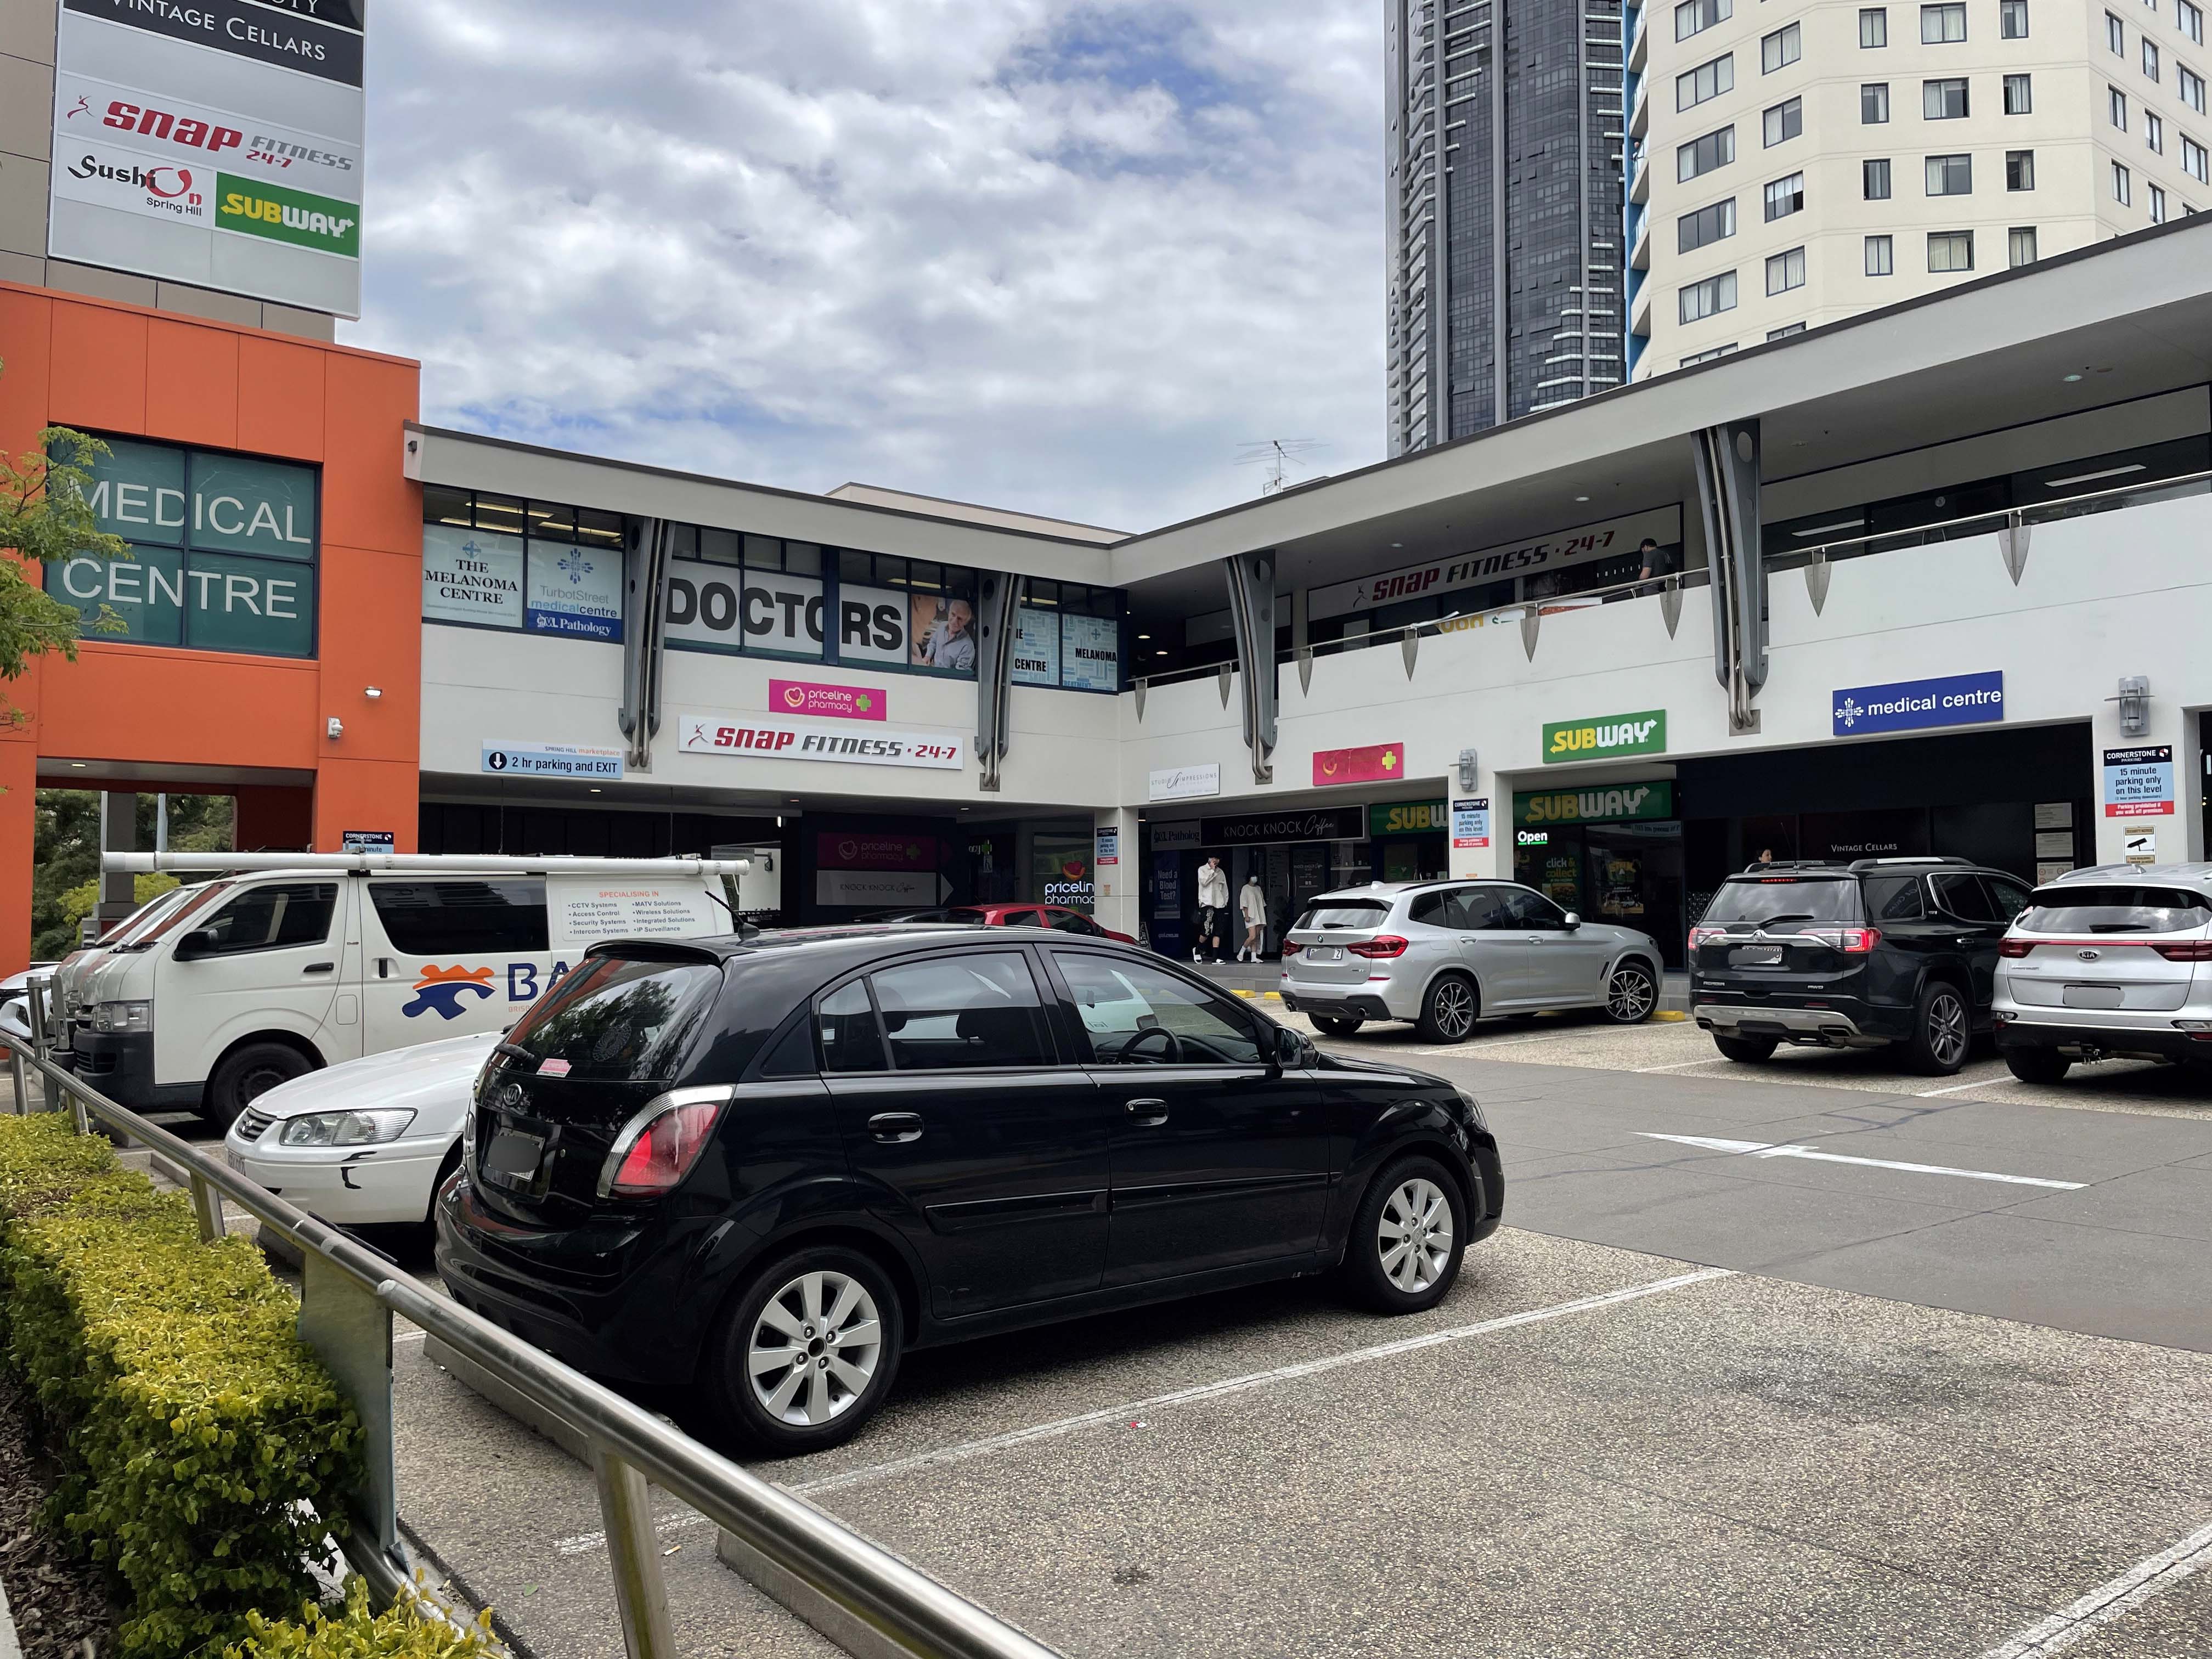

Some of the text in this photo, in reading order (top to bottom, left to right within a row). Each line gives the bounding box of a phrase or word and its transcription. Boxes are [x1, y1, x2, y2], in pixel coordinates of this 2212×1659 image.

[113, 0, 325, 61] INTAGE CELLARS
[246, 149, 293, 168] 24-7
[250, 135, 353, 171] FITNESS
[67, 155, 156, 189] Sushi
[146, 196, 202, 216] Spring Hill
[221, 193, 354, 238] SUBWAY
[68, 479, 312, 544] MEDICAL
[1446, 544, 1550, 584] FITNESS
[1563, 531, 1615, 556] 24-7
[456, 558, 489, 573] THE
[63, 558, 297, 619] CENTRE
[425, 570, 518, 592] MELANOMA
[440, 586, 504, 605] CENTRE
[560, 618, 612, 636] Pathology
[1075, 647, 1117, 662] MELANOMA
[1015, 658, 1047, 672] CENTRE
[808, 689, 852, 702] priceline
[1867, 689, 2002, 716] medical centre
[808, 699, 853, 714] pharmacy
[1550, 718, 1657, 754] SUBWAY
[579, 748, 620, 758] marketplace
[801, 735, 903, 757] FITNESS
[915, 744, 957, 760] 24-7
[2106, 749, 2157, 760] CORNERSTONE
[512, 757, 618, 773] 2 hr parking and EXIT
[2120, 766, 2157, 776] 15 minute
[2115, 776, 2162, 787] parking only
[2128, 786, 2141, 794] this
[2143, 785, 2162, 793] level
[1525, 786, 1650, 823] SUBWAY
[1385, 804, 1448, 832] SUBW
[1224, 814, 1335, 838] KNOCK KNOCK Coffee
[1168, 830, 1200, 842] Patholog
[1517, 831, 1548, 845] Open
[860, 842, 903, 853] priceline
[1831, 842, 1898, 853] VINTAGE CELLARS
[1546, 857, 1567, 868] click
[1157, 869, 1173, 879] Need
[1045, 881, 1094, 896] pricelin
[1159, 881, 1177, 890] Blood
[1045, 893, 1095, 905] pharmac
[1160, 890, 1176, 900] Test?
[508, 961, 569, 1002] BA
